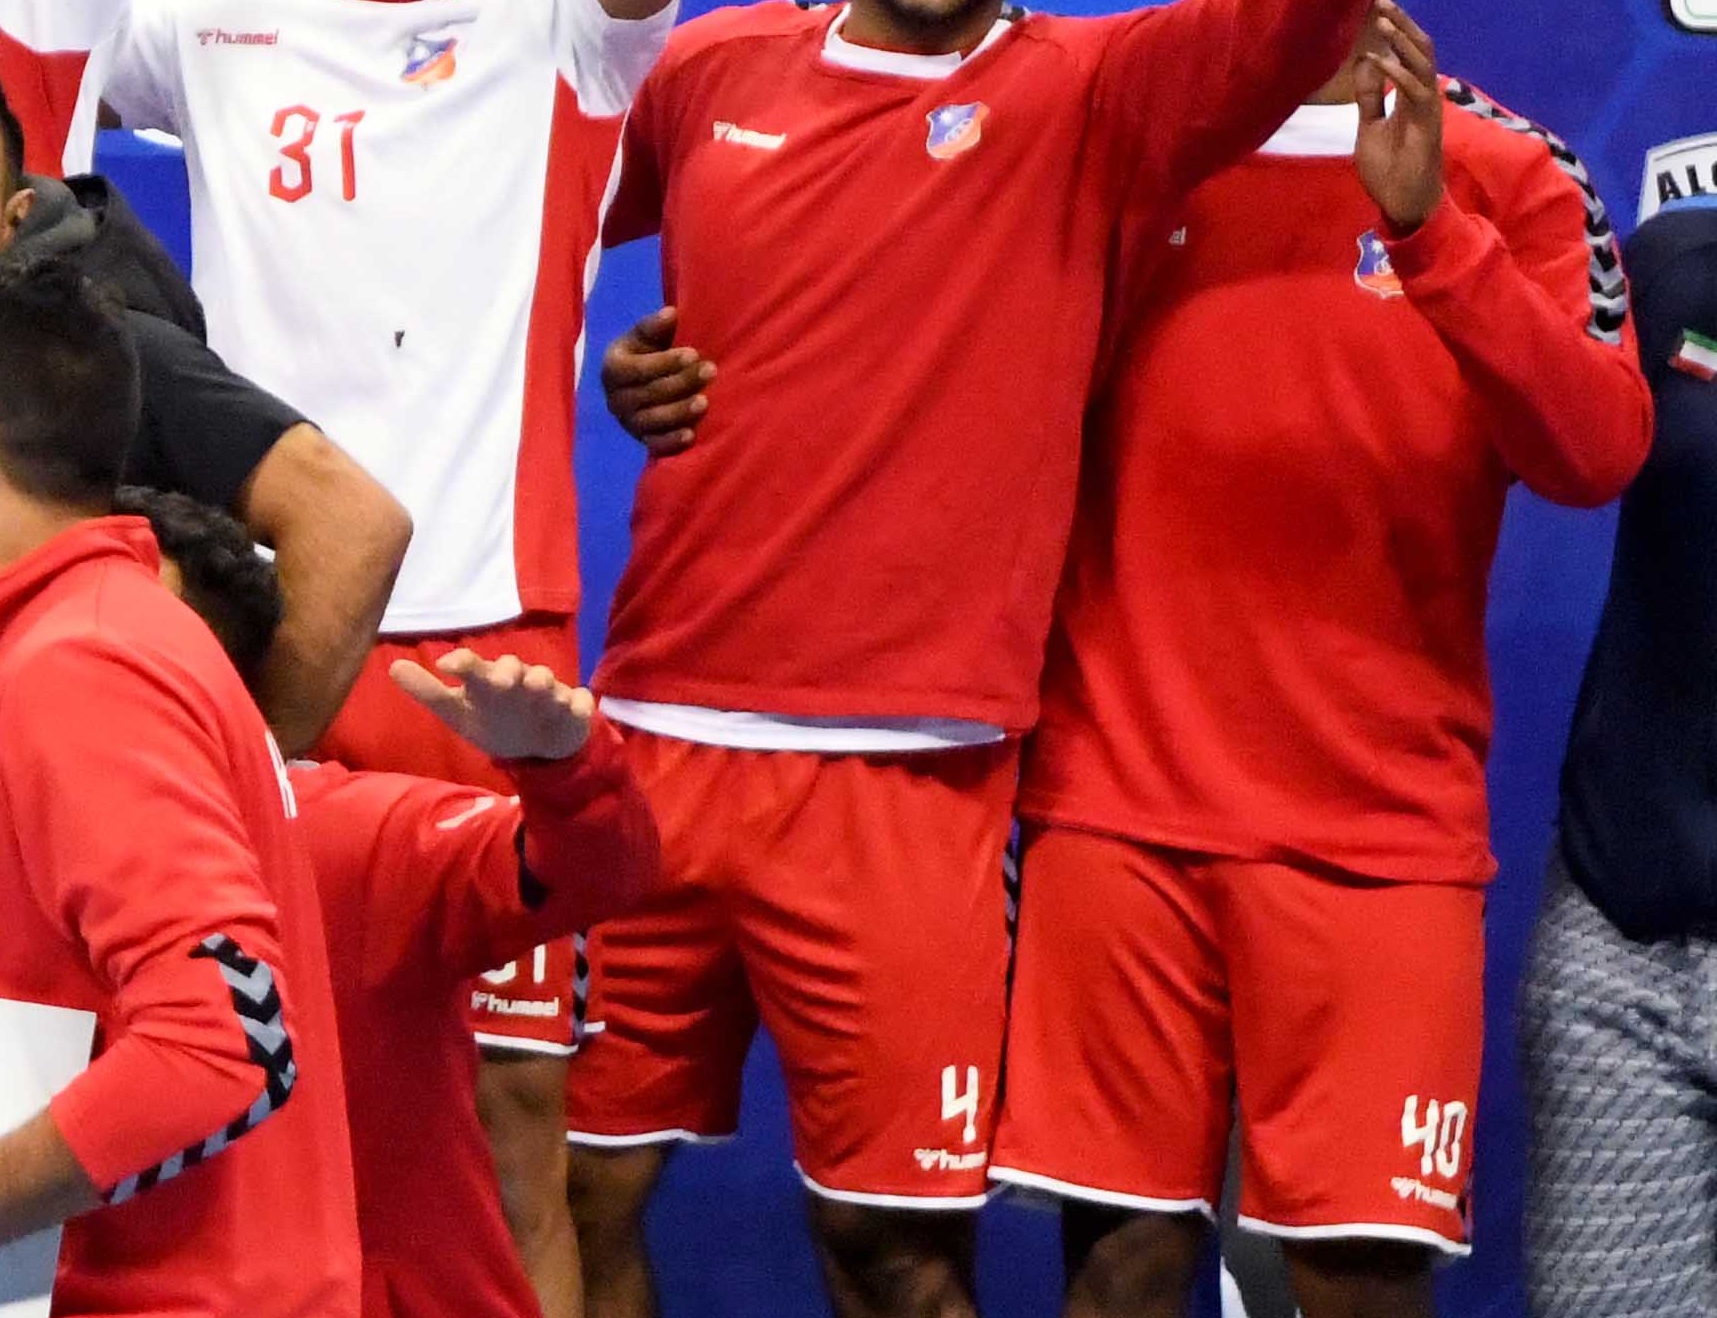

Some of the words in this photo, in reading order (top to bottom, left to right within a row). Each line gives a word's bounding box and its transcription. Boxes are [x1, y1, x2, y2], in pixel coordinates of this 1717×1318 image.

[215, 27, 280, 46] hummel
[268, 104, 365, 204] 31
[940, 1065, 979, 1147] 4
[1400, 1094, 1469, 1179] 40
